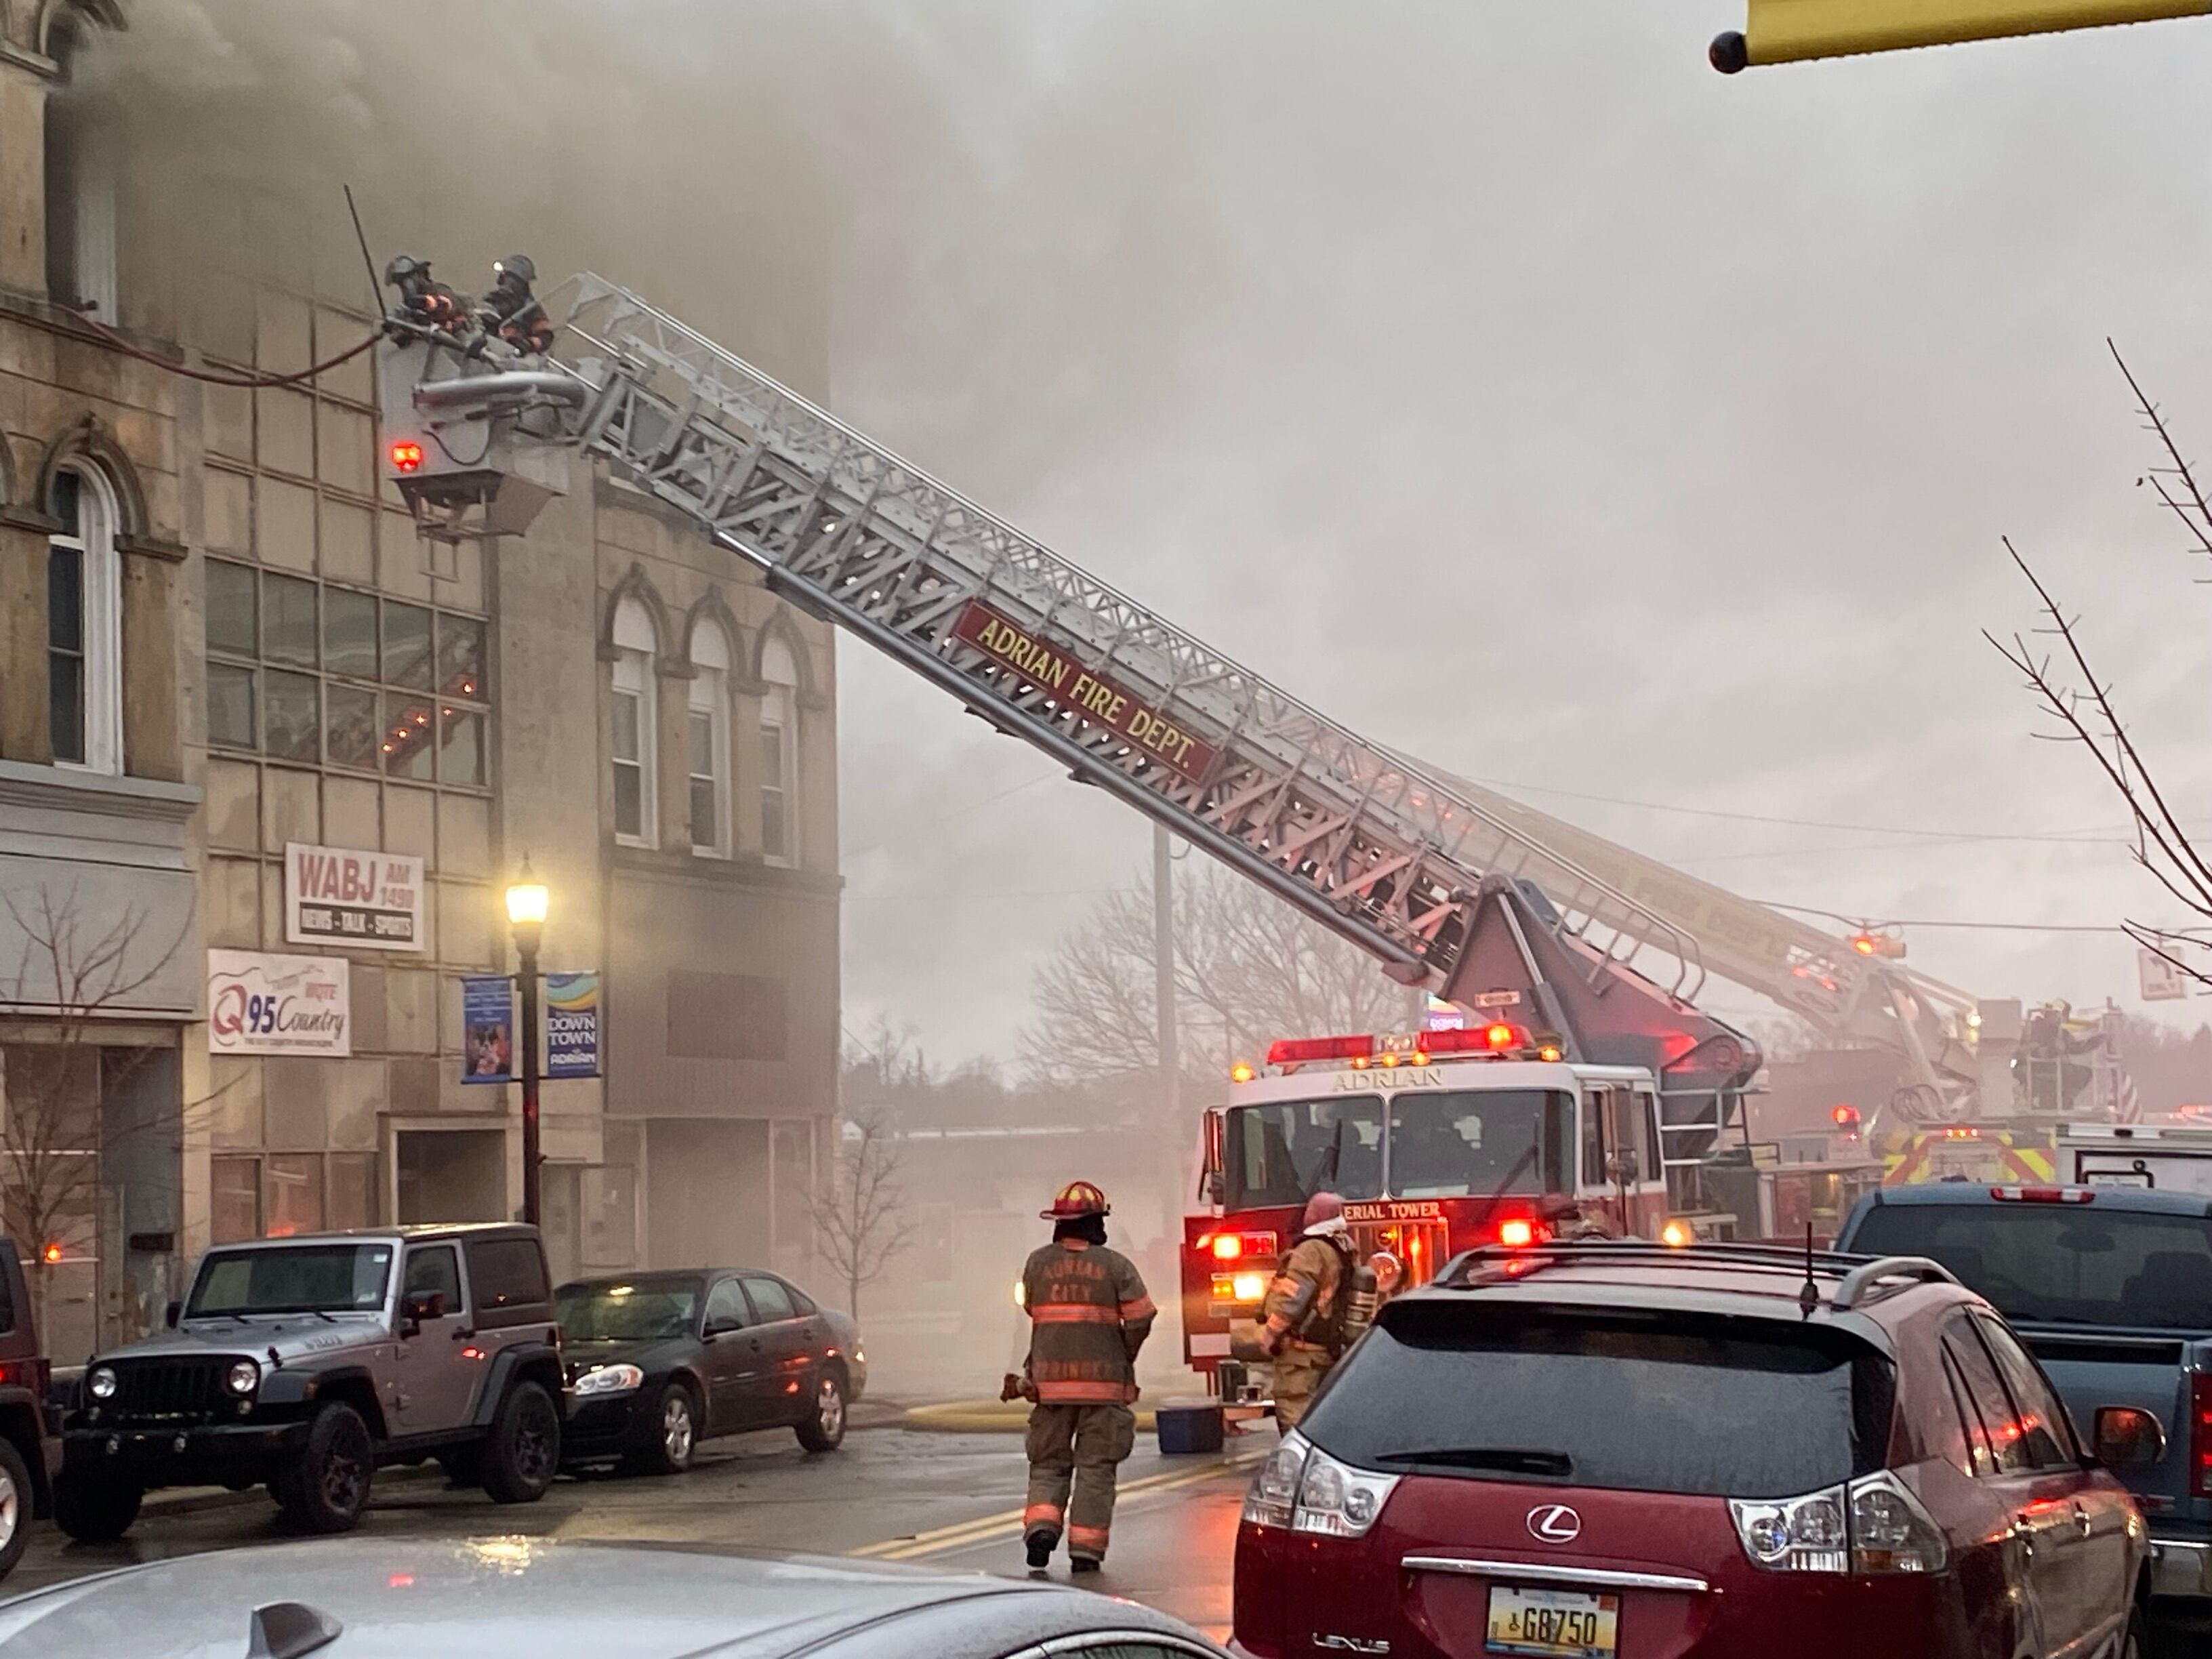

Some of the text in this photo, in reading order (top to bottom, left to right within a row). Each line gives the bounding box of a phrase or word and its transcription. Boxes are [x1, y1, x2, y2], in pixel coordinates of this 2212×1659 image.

[977, 619, 1195, 768] ADRIAN FIRE DEPT.
[298, 853, 377, 902] WABJ
[548, 1017, 596, 1030] DOWN
[548, 1031, 596, 1045] TOWN
[1333, 1068, 1442, 1092] ADRIAN
[1343, 1202, 1441, 1220] ERIAL TOWER
[1051, 1284, 1090, 1302] CITY
